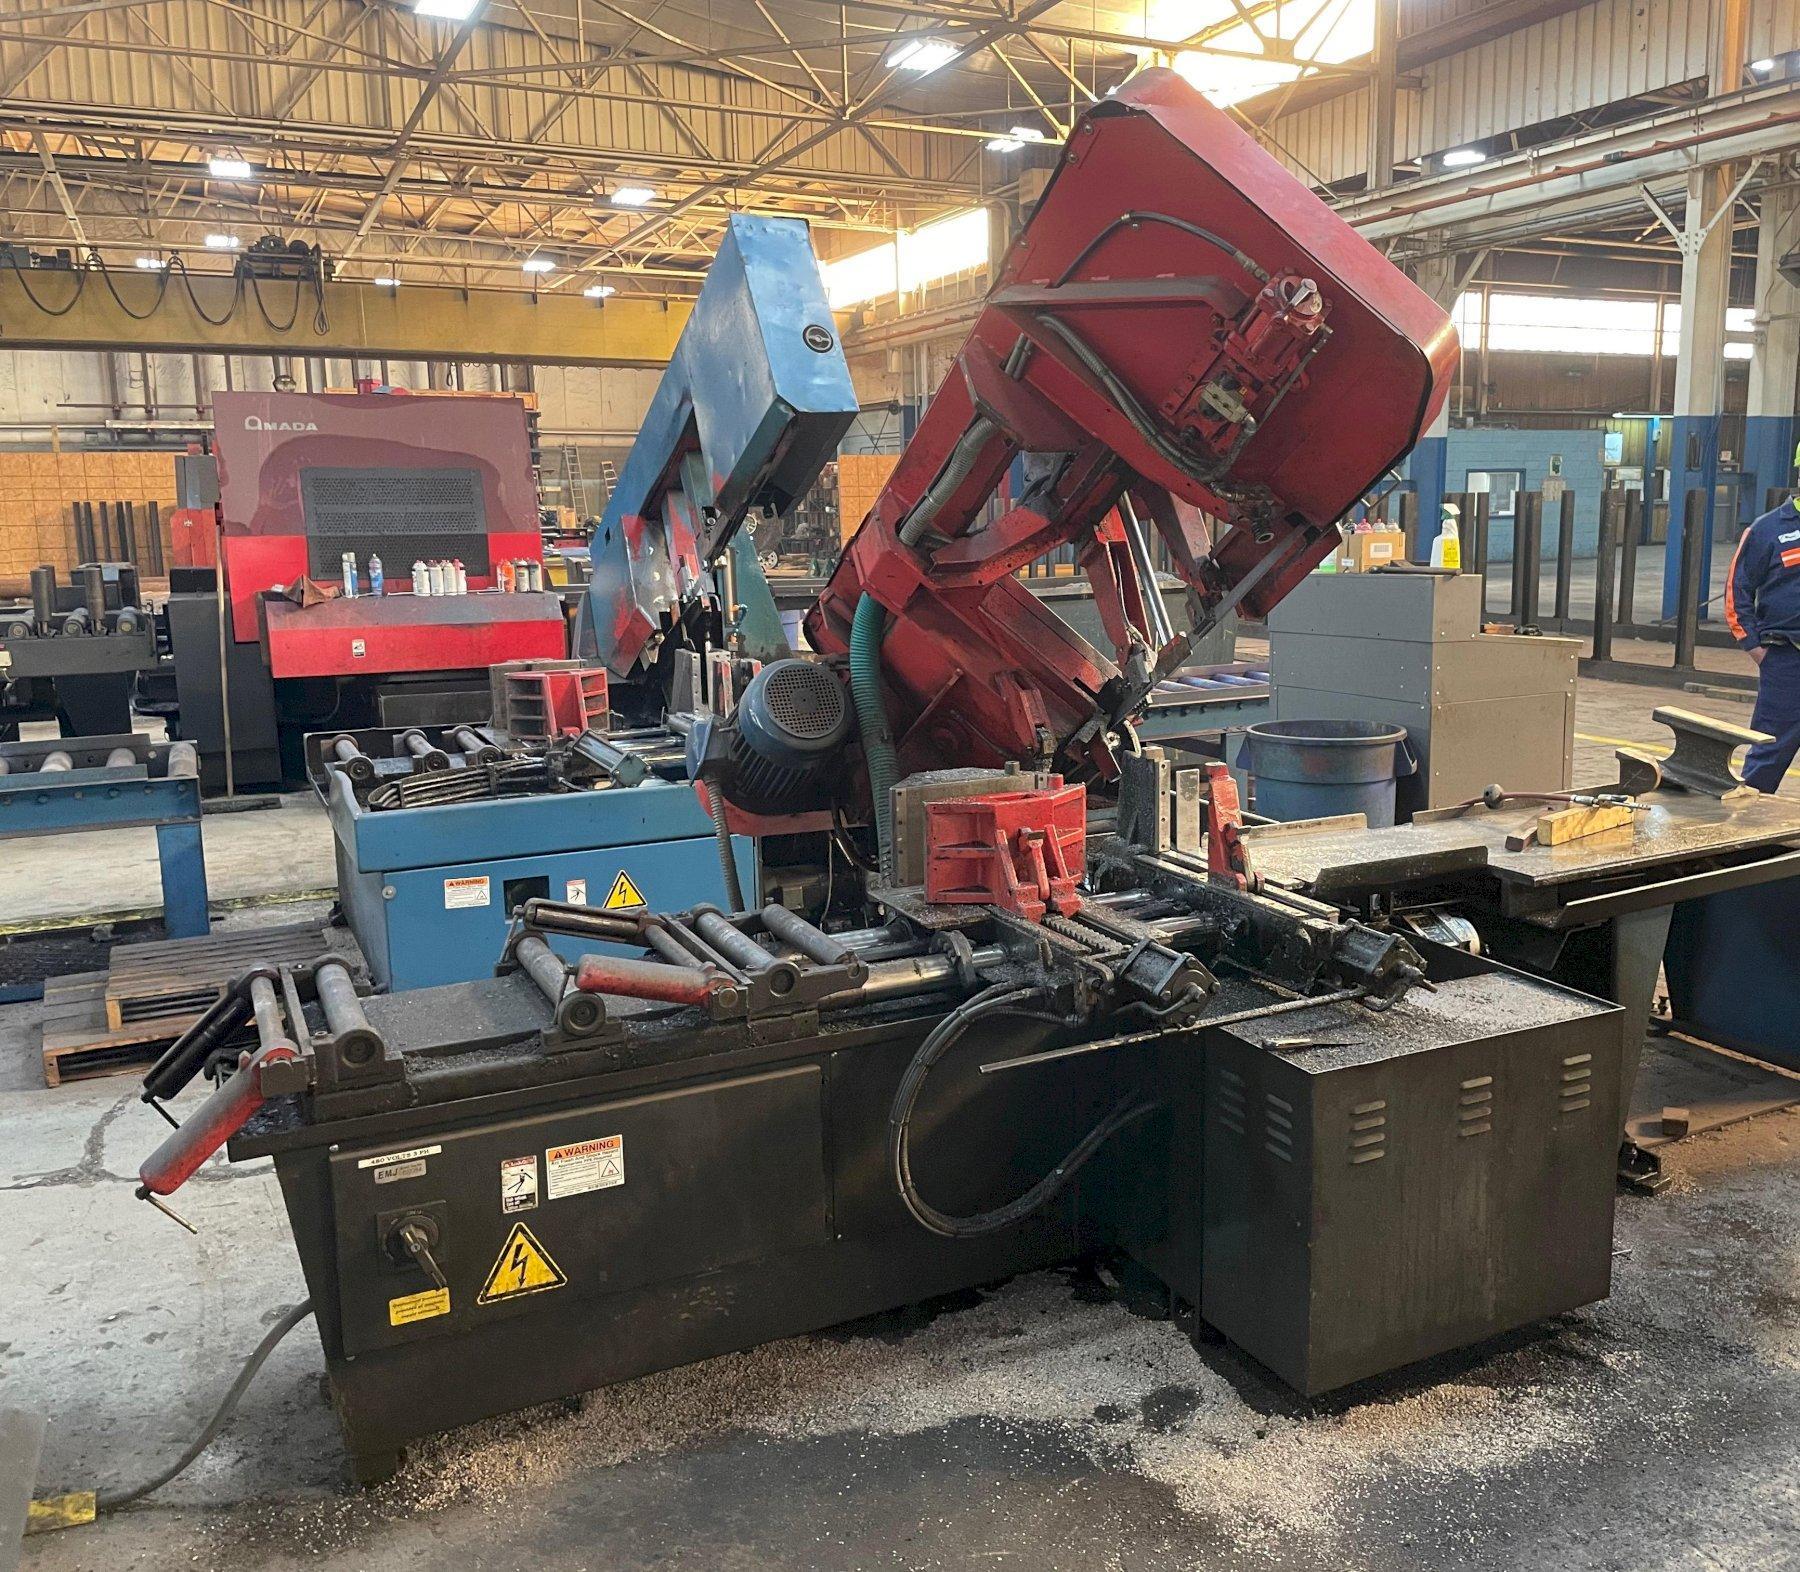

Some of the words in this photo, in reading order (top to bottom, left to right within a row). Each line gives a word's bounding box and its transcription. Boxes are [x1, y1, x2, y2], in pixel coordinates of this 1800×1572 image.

[244, 415, 318, 431] AMADA
[564, 1140, 614, 1156] WARNING
[378, 1168, 398, 1180] EMJ
